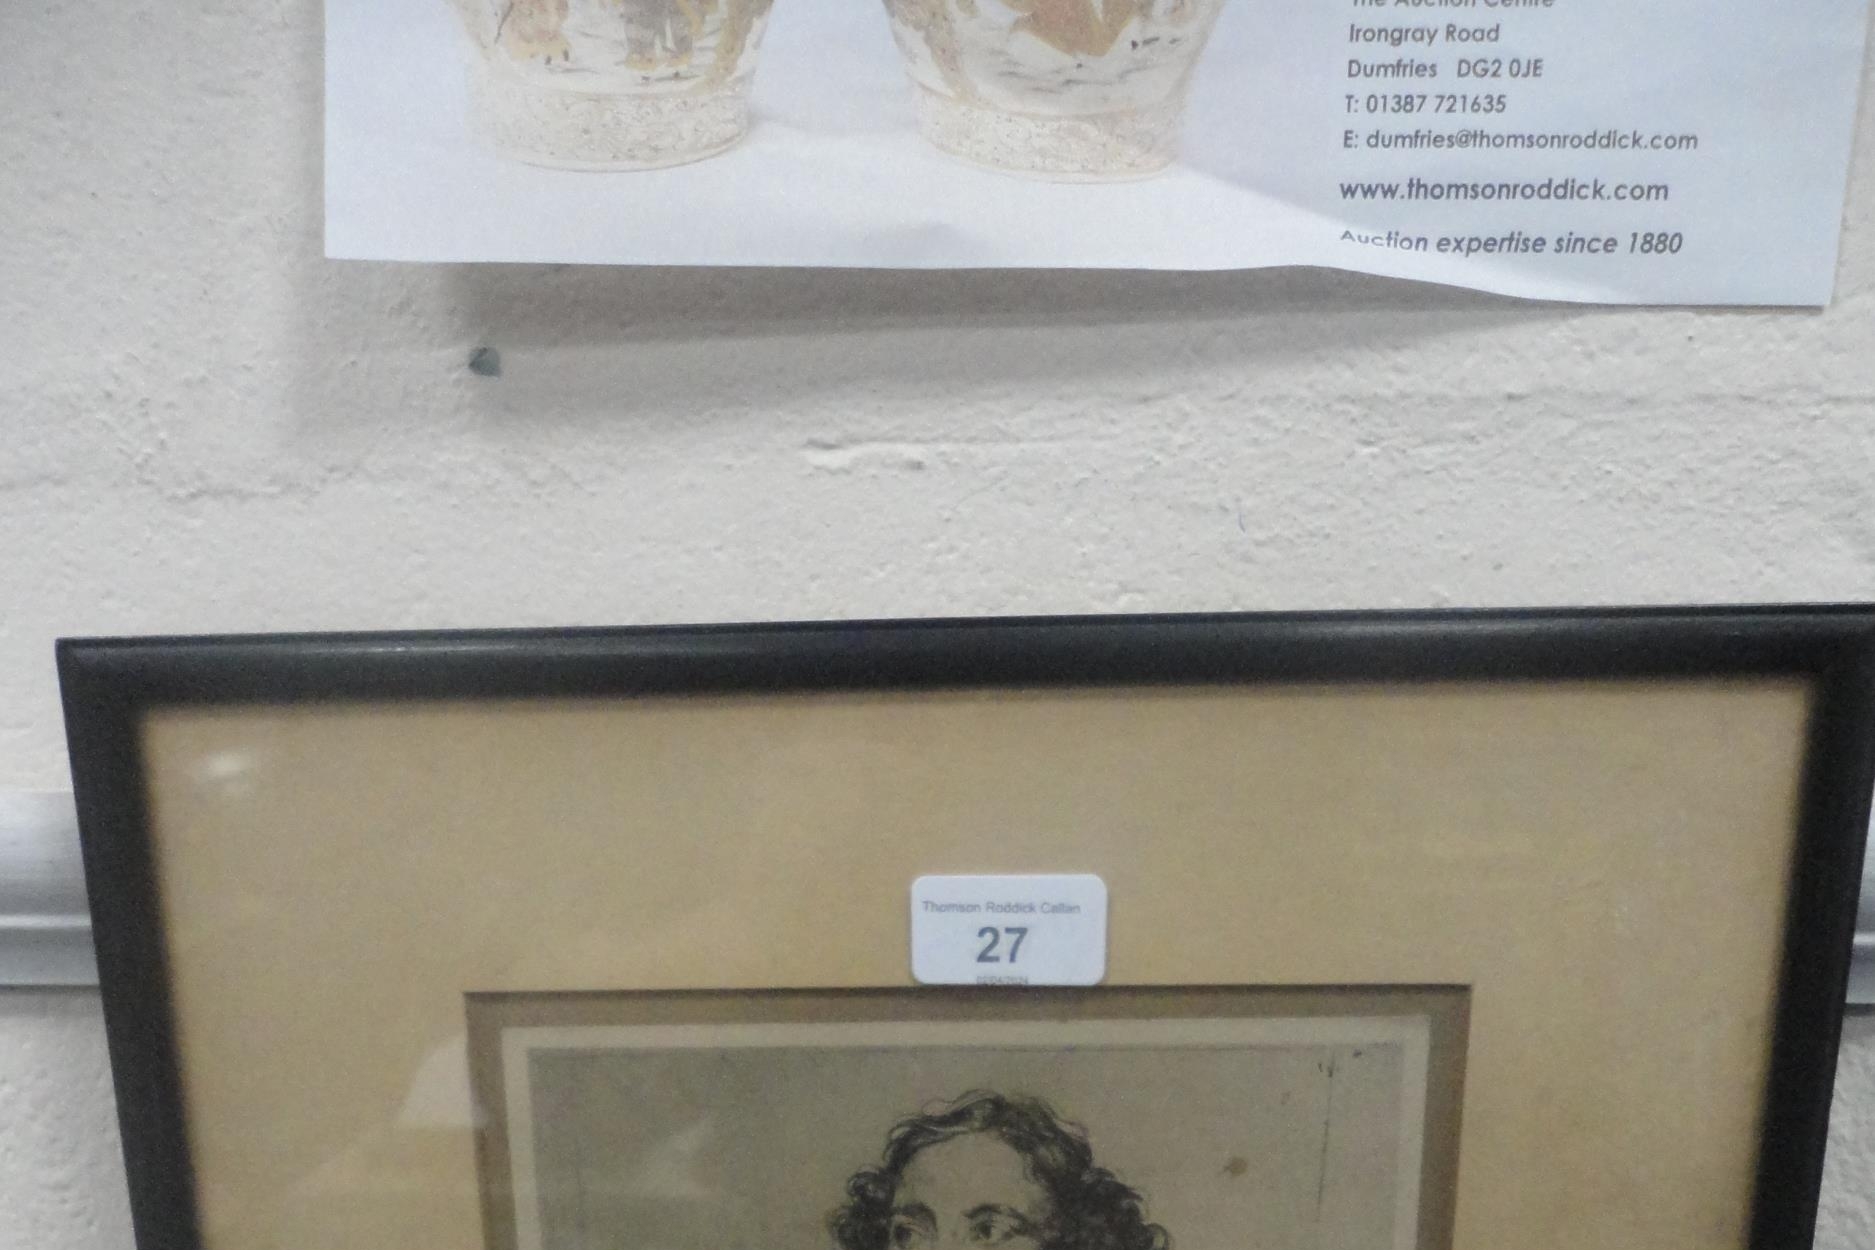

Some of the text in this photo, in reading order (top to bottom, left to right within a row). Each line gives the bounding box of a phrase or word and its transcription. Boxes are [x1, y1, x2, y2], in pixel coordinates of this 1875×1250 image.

[1349, 23, 1501, 48] Irongray Road
[1347, 57, 1544, 79] Dumfries DG2 0JE
[1344, 93, 1507, 114] T: 01387 721635
[1343, 128, 1699, 150] E: dumfries@thomsonroddick.com
[1339, 176, 1670, 201] www.thomsonroddick.com
[1340, 229, 1684, 259] Auction expertise since 1880
[922, 900, 981, 914] Thomson
[985, 900, 1036, 914] Roddick
[976, 926, 1028, 964] 27
